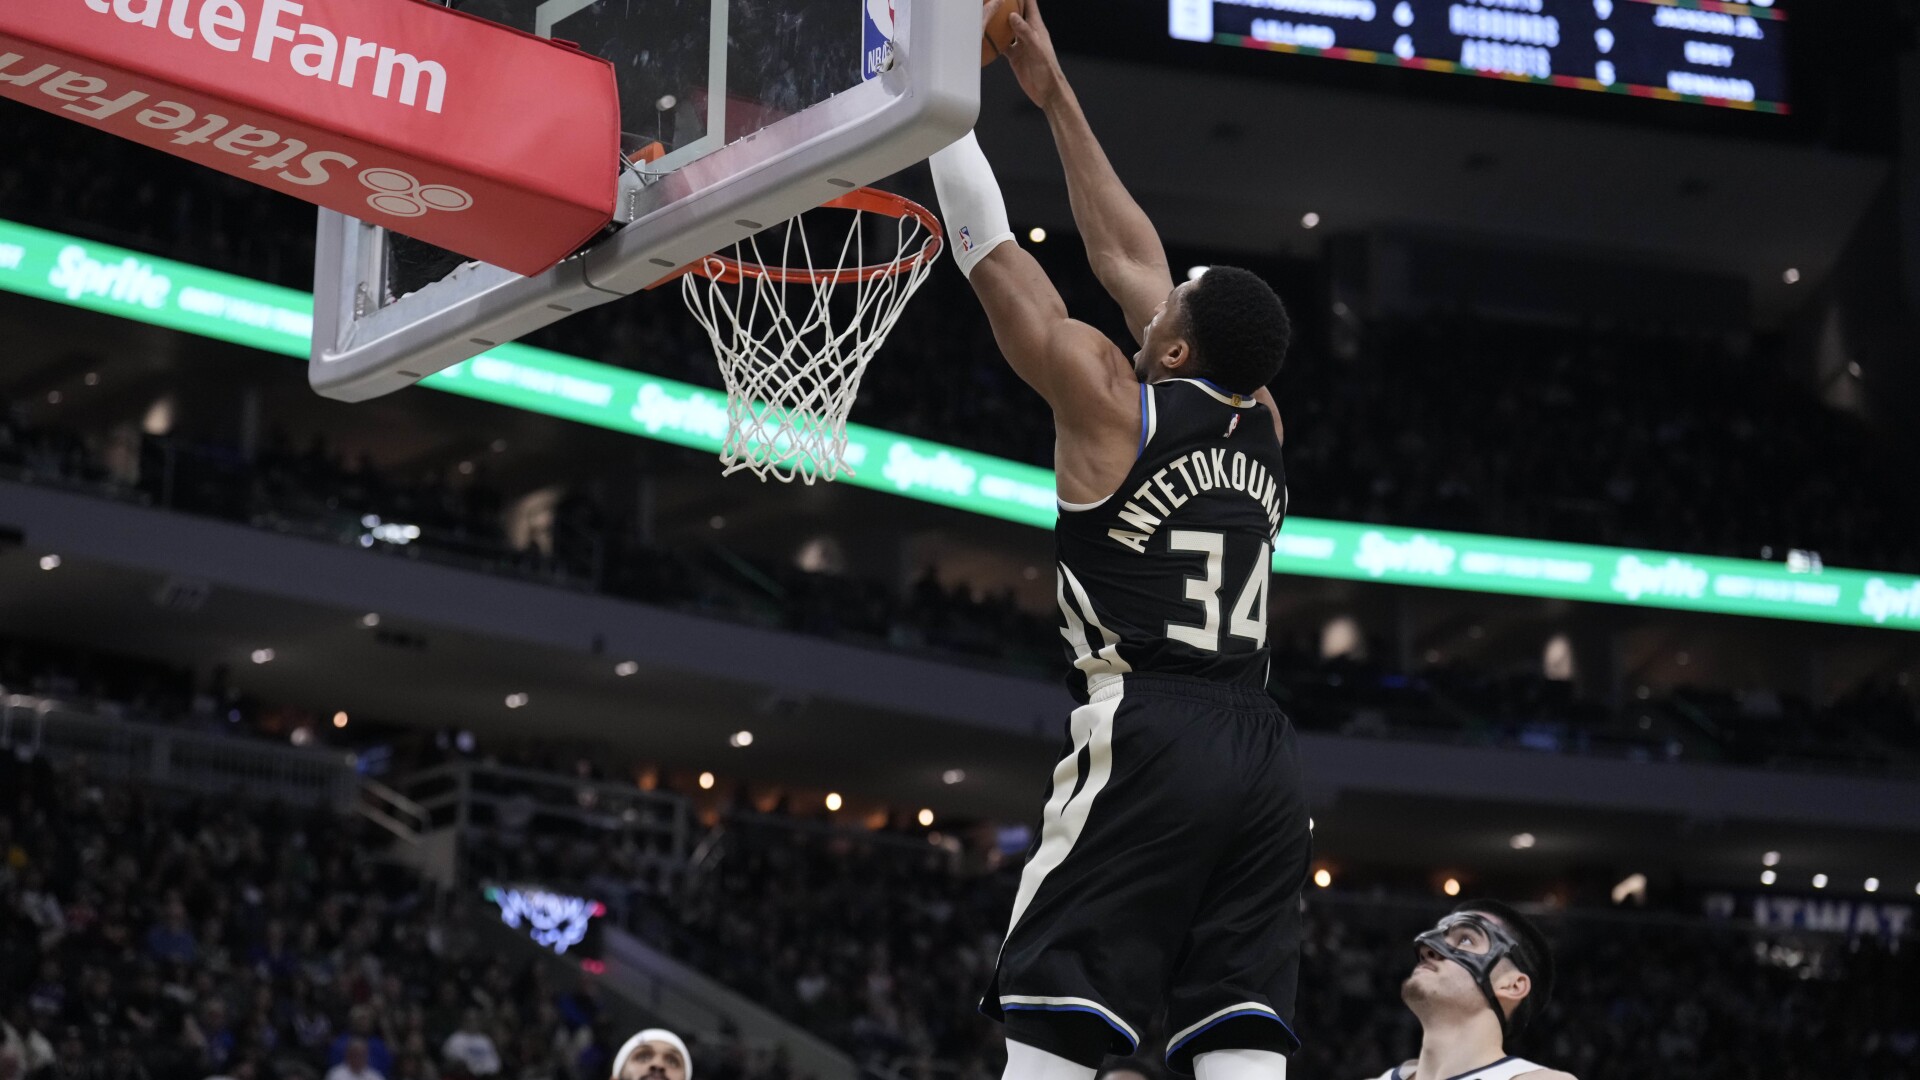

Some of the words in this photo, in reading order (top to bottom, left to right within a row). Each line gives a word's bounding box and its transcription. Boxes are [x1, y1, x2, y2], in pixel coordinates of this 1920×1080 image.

[84, 0, 447, 114] ateFarm
[48, 244, 171, 309] Sprite
[882, 441, 976, 497] Sprite
[1107, 447, 1281, 554] ANTETOKOUNM
[1353, 530, 1456, 577] Sprite
[1610, 554, 1709, 600] Sprite
[1165, 530, 1271, 652] 34
[1858, 577, 1920, 624] Spri
